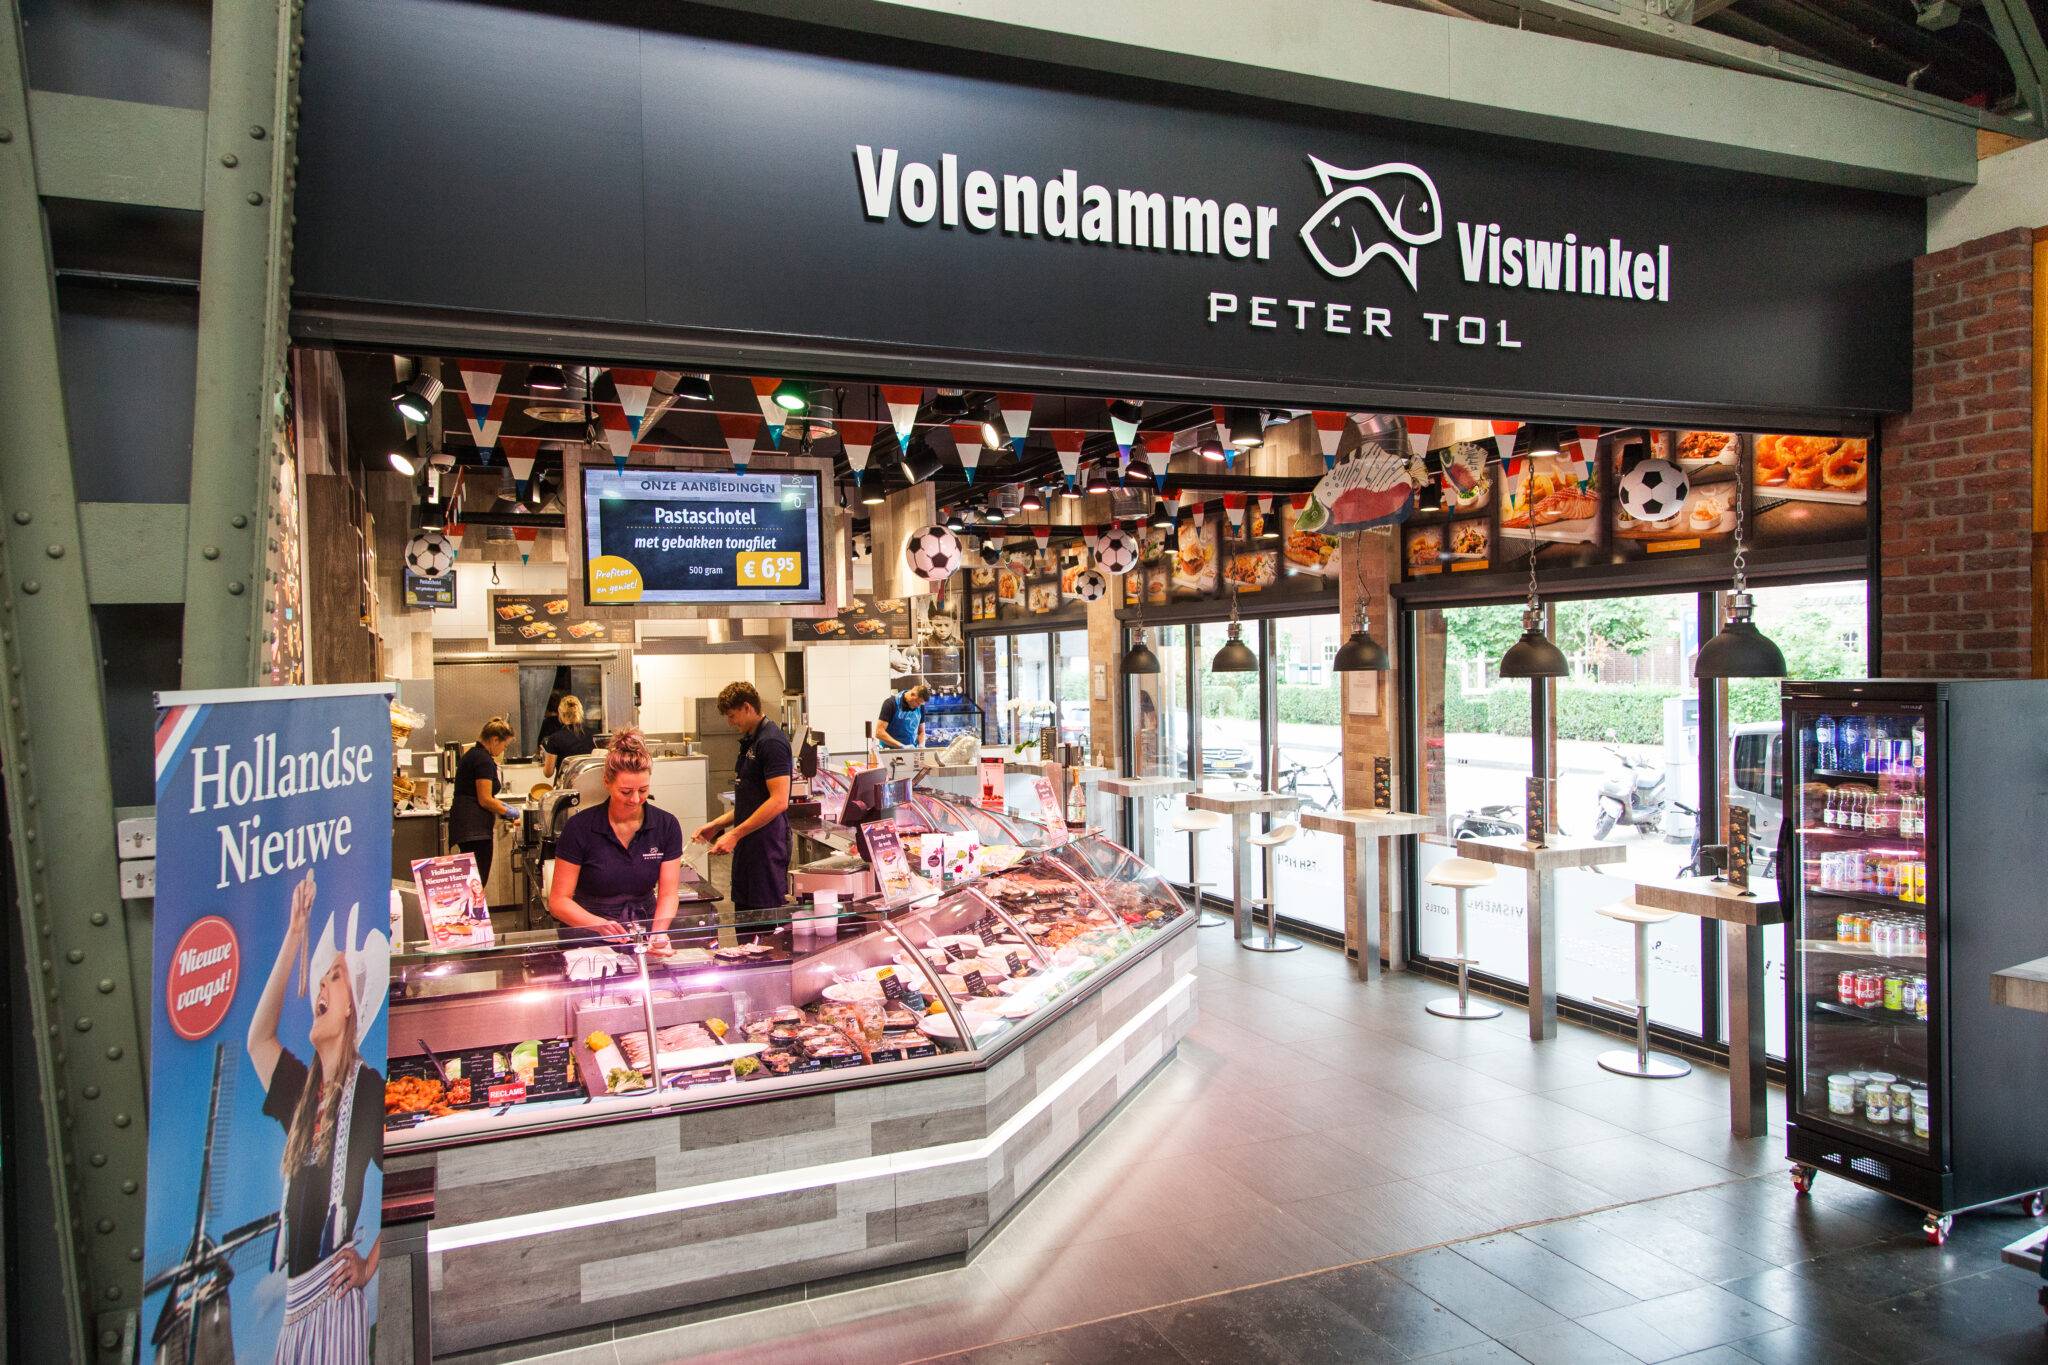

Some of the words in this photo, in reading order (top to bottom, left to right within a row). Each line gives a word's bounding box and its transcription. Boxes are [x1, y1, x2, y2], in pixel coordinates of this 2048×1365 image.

[856, 144, 1277, 260] Volendammer
[1457, 221, 1670, 303] Viswinkel
[1209, 292, 1392, 338] PETER
[1424, 312, 1522, 348] TOL
[640, 480, 677, 491] ONZE
[681, 481, 775, 493] AANBIEDINGEN
[655, 507, 756, 525] Pastaschotel
[634, 536, 659, 549] met
[661, 535, 722, 551] gebakken
[725, 535, 776, 552] tongfilet
[689, 566, 703, 574] 500
[704, 567, 723, 577] gram
[761, 557, 795, 583] 6,95
[189, 726, 374, 814] Hollandse
[216, 814, 352, 889] Nieuwe
[431, 867, 462, 876] Hollandse
[178, 940, 231, 977] Nieuwe
[176, 973, 231, 1012] vangst!
[490, 1087, 525, 1099] RECLAME
